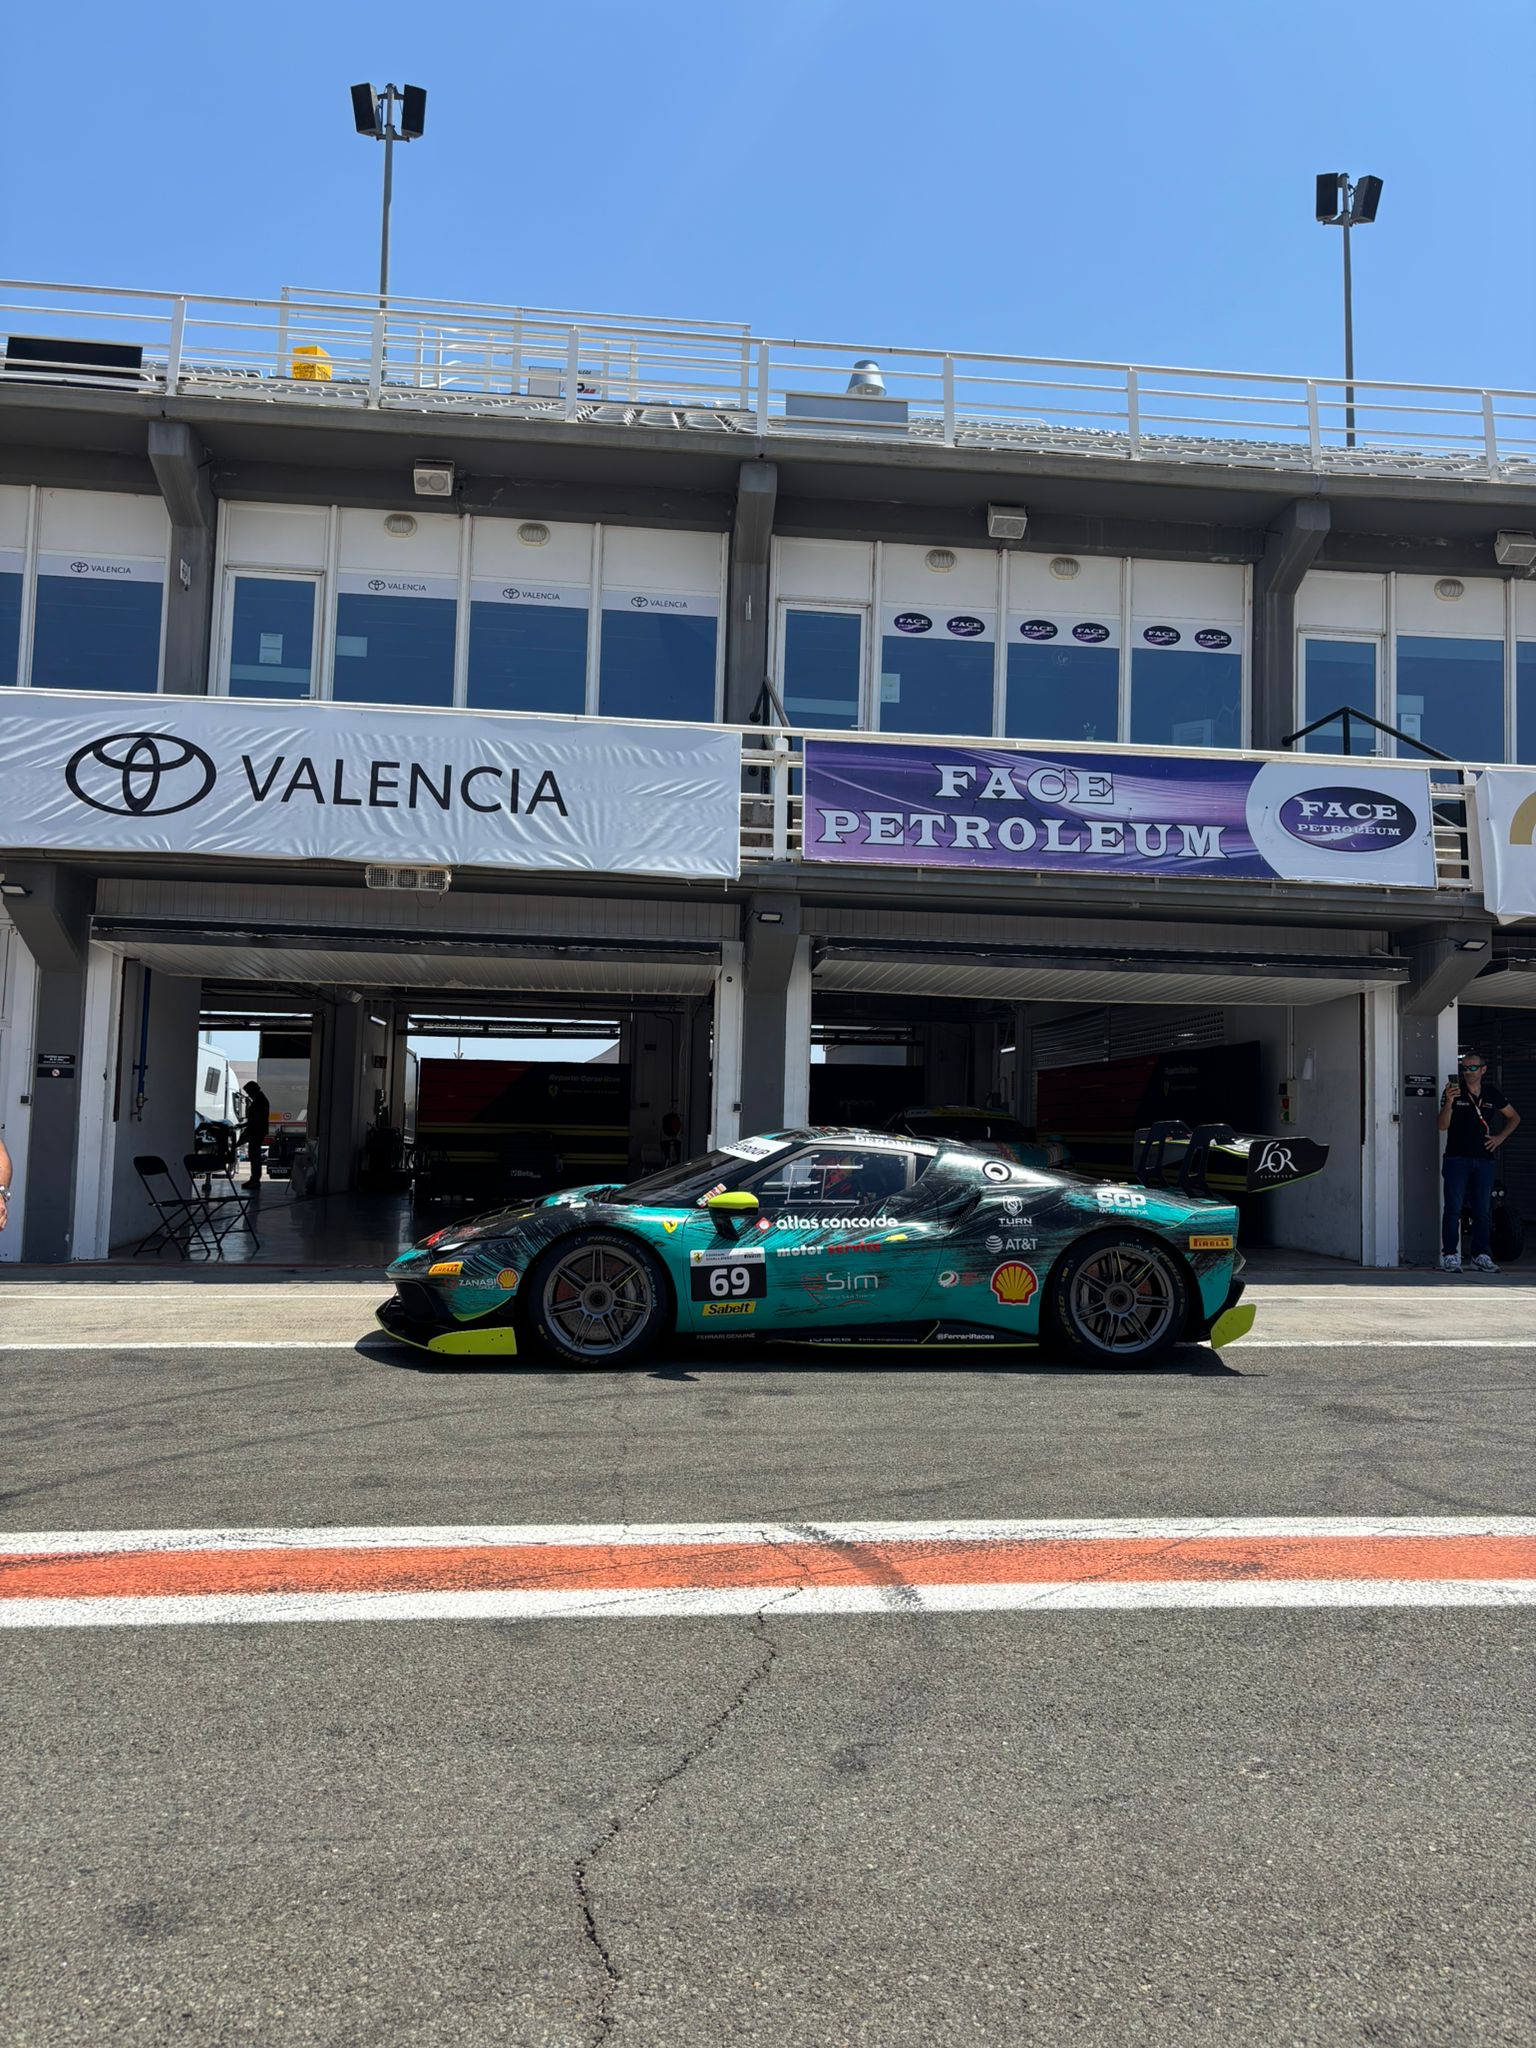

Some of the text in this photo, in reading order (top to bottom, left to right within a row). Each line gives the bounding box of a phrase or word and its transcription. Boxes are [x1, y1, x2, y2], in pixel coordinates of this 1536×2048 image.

[91, 564, 132, 575] VALENCIA
[387, 582, 427, 592] VALENCIA
[521, 591, 561, 601] VALENCIA
[649, 599, 688, 609] VALENCIA
[898, 617, 929, 625] FACE
[951, 621, 982, 629] FACE
[1077, 627, 1106, 635] FACE
[1148, 630, 1177, 638] FACE
[242, 754, 569, 818] VALENCIA
[933, 763, 1114, 805] FACE
[1299, 800, 1398, 821] FACE
[816, 808, 1231, 860] PETROLEUM
[1297, 823, 1401, 837] PETROLEUM
[1096, 1192, 1147, 1209] SCP
[776, 1215, 899, 1230] atlas concorde
[997, 1217, 1033, 1225] TURN
[1005, 1238, 1038, 1251] AT&T
[1193, 1238, 1230, 1247] PIRELLI
[776, 1244, 824, 1257] motor
[432, 1263, 459, 1273] PIRELLI
[458, 1278, 496, 1287] ZANASI
[709, 1266, 751, 1297] 69
[825, 1272, 878, 1291] Sim
[707, 1303, 751, 1315] Sabelt
